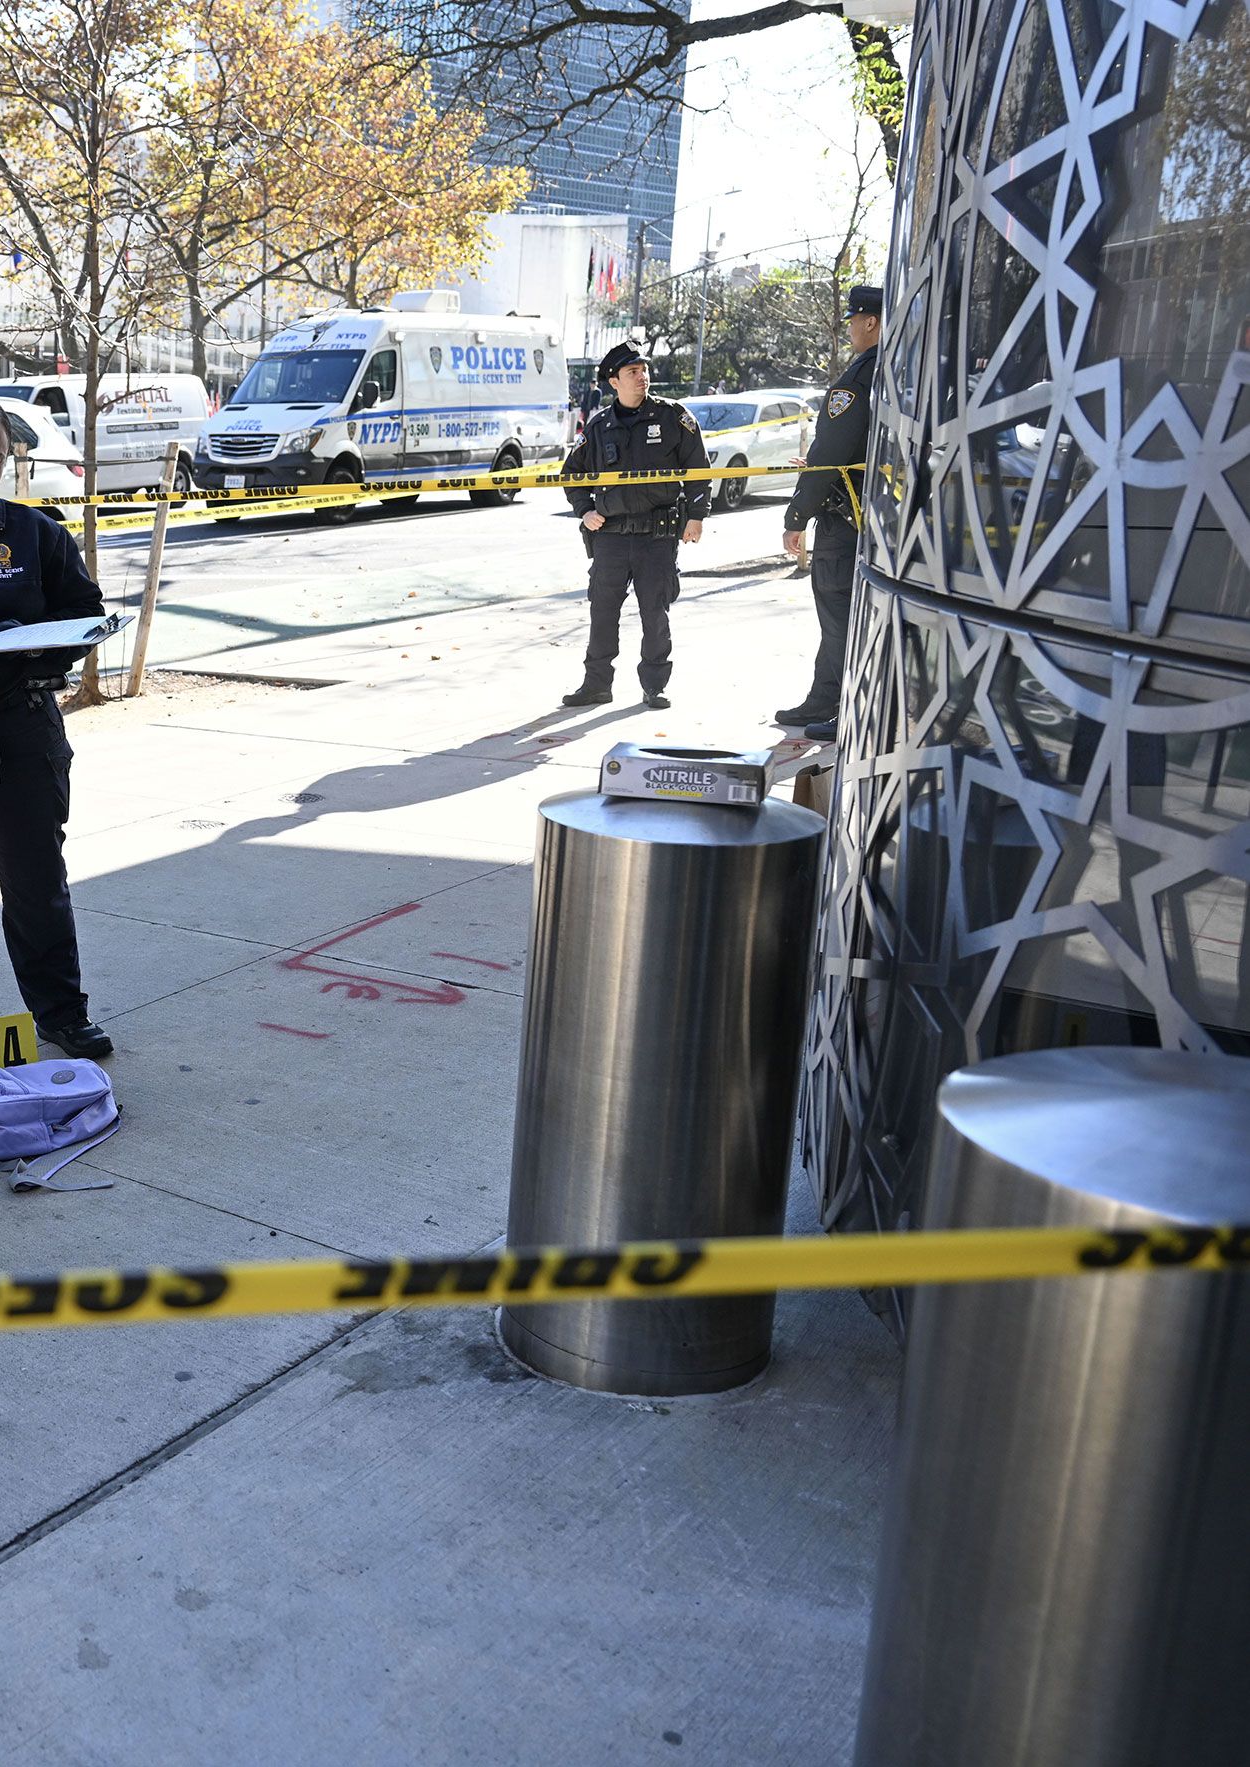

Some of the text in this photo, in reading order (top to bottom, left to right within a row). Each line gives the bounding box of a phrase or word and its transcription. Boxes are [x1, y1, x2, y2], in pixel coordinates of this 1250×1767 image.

[451, 346, 526, 370] POLICE
[458, 373, 522, 384] CRIME SCENE UNIT
[358, 422, 401, 445] NYPD
[650, 768, 712, 785] NITRILE
[645, 782, 677, 791] BLACK
[680, 784, 715, 794] GLOVES
[3, 1025, 27, 1068] 4
